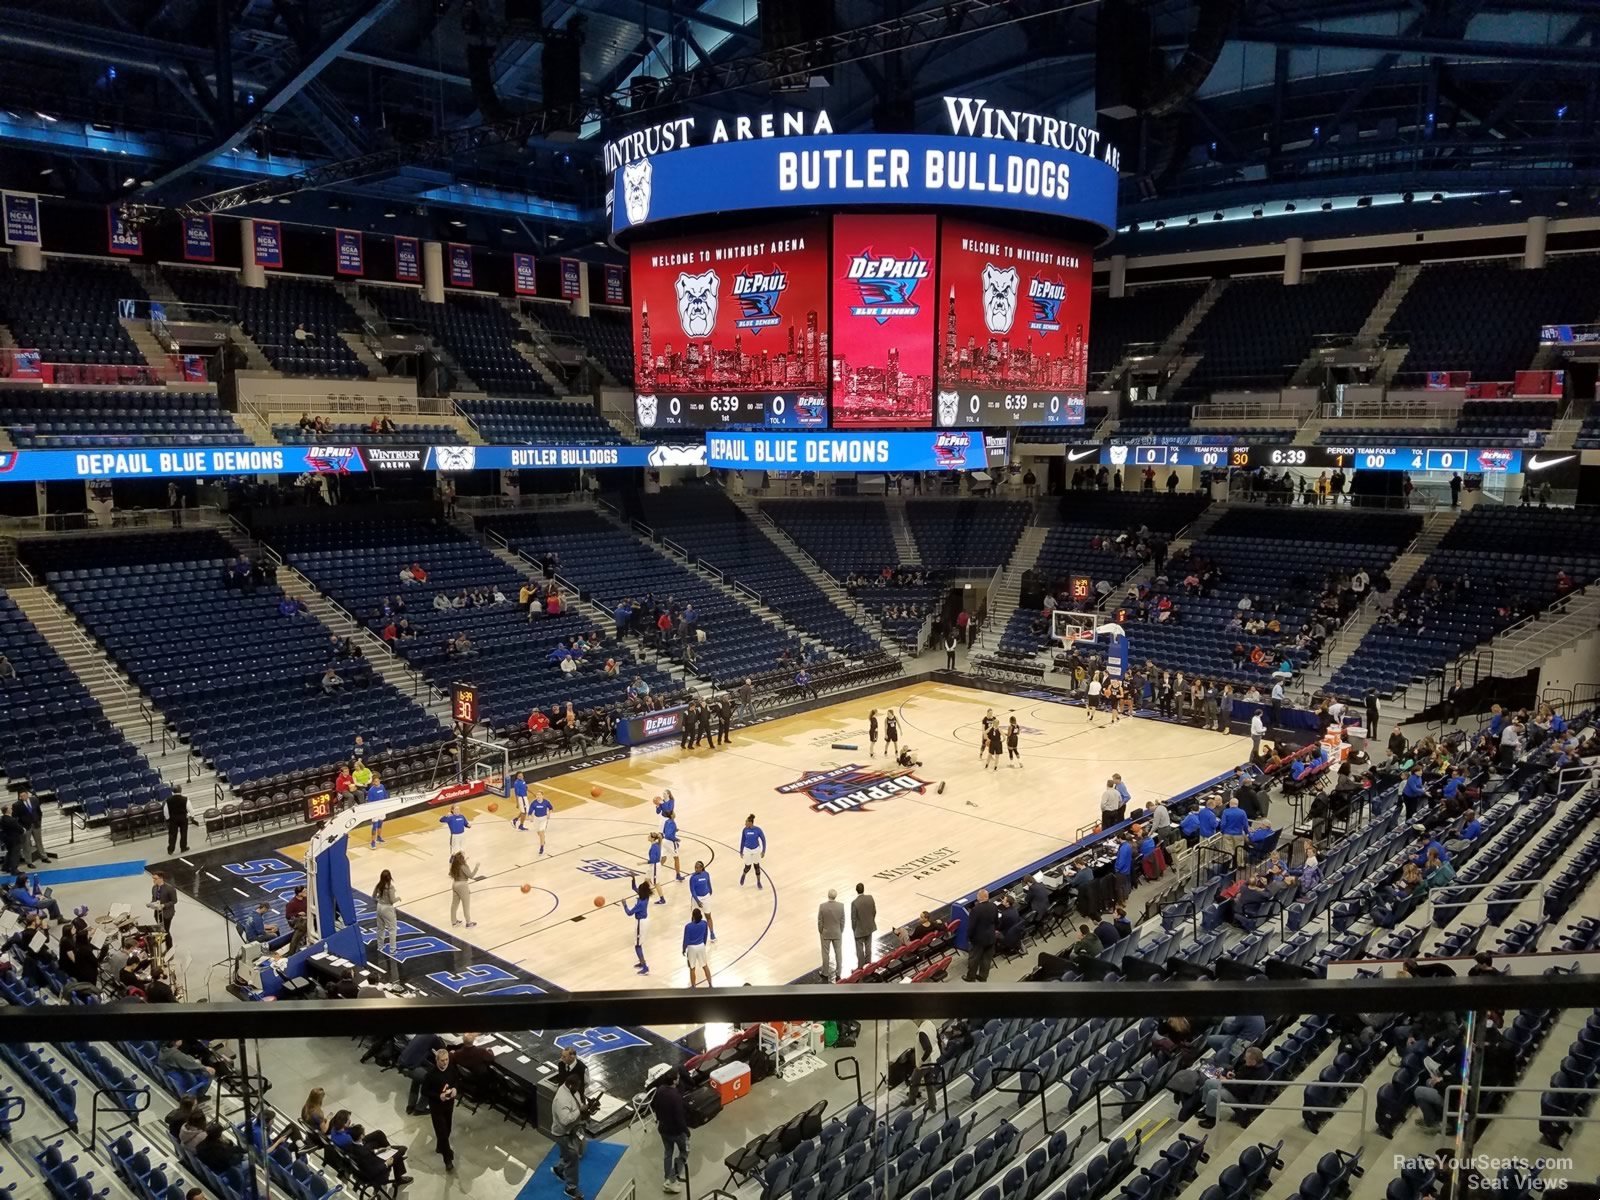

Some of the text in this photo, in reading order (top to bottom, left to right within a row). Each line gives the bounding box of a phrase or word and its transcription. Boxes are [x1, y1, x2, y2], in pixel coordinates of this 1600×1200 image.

[712, 109, 833, 143] ARENA
[943, 96, 1100, 158] WINTRUST
[779, 149, 1070, 200] BUTLER BULLDOGS
[112, 235, 138, 245] 1945
[652, 238, 805, 267] WELCOME TO WINTRUST ARENA
[962, 239, 1079, 268] WELCOME TO WINTRUST ARENA
[856, 307, 916, 315] BLUE DEMONS
[670, 397, 680, 415] 0
[710, 396, 739, 411] 6:39
[772, 396, 785, 415] 0
[970, 395, 980, 414] 0
[1005, 395, 1027, 410] 6:39
[1050, 396, 1059, 414] 0
[369, 449, 420, 459] WINTRUST
[511, 449, 618, 466] BUTLER BULLDOGS
[711, 438, 889, 464] DEPAUL BLUE DEMONS
[1147, 449, 1156, 462] 0
[1170, 453, 1178, 463] 4
[1203, 453, 1217, 464] 00
[1272, 450, 1306, 464] 6:39
[76, 450, 284, 475] DEPAUL BLUE DEMONS
[1233, 454, 1249, 465] 30
[1336, 455, 1343, 467] 1
[1366, 455, 1385, 468] 00
[1411, 456, 1421, 468] 4
[1441, 453, 1452, 467] 0
[1075, 586, 1085, 596] 30
[457, 701, 473, 720] 30
[312, 794, 330, 805] 6:39
[313, 804, 326, 817] 30
[872, 846, 954, 880] WINTRUST
[912, 858, 960, 880] ARENA
[732, 1078, 741, 1091] G
